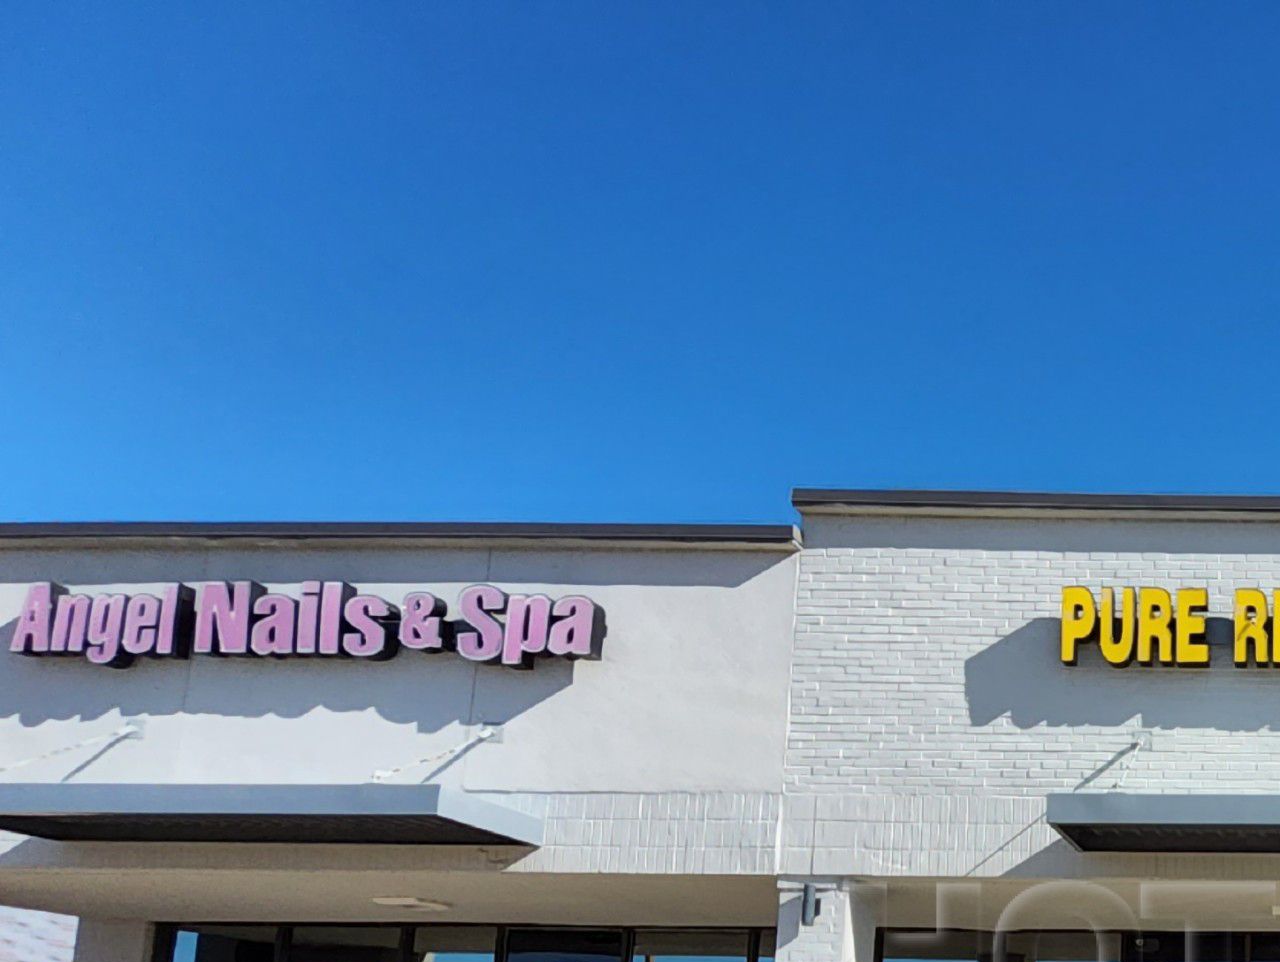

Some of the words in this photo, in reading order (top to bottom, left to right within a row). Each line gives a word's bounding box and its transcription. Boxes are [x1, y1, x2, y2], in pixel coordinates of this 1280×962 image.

[8, 581, 186, 665] Angel
[194, 581, 391, 658] Nails
[400, 592, 444, 650] &
[457, 584, 598, 665] Spa
[1061, 586, 1210, 665] PURE
